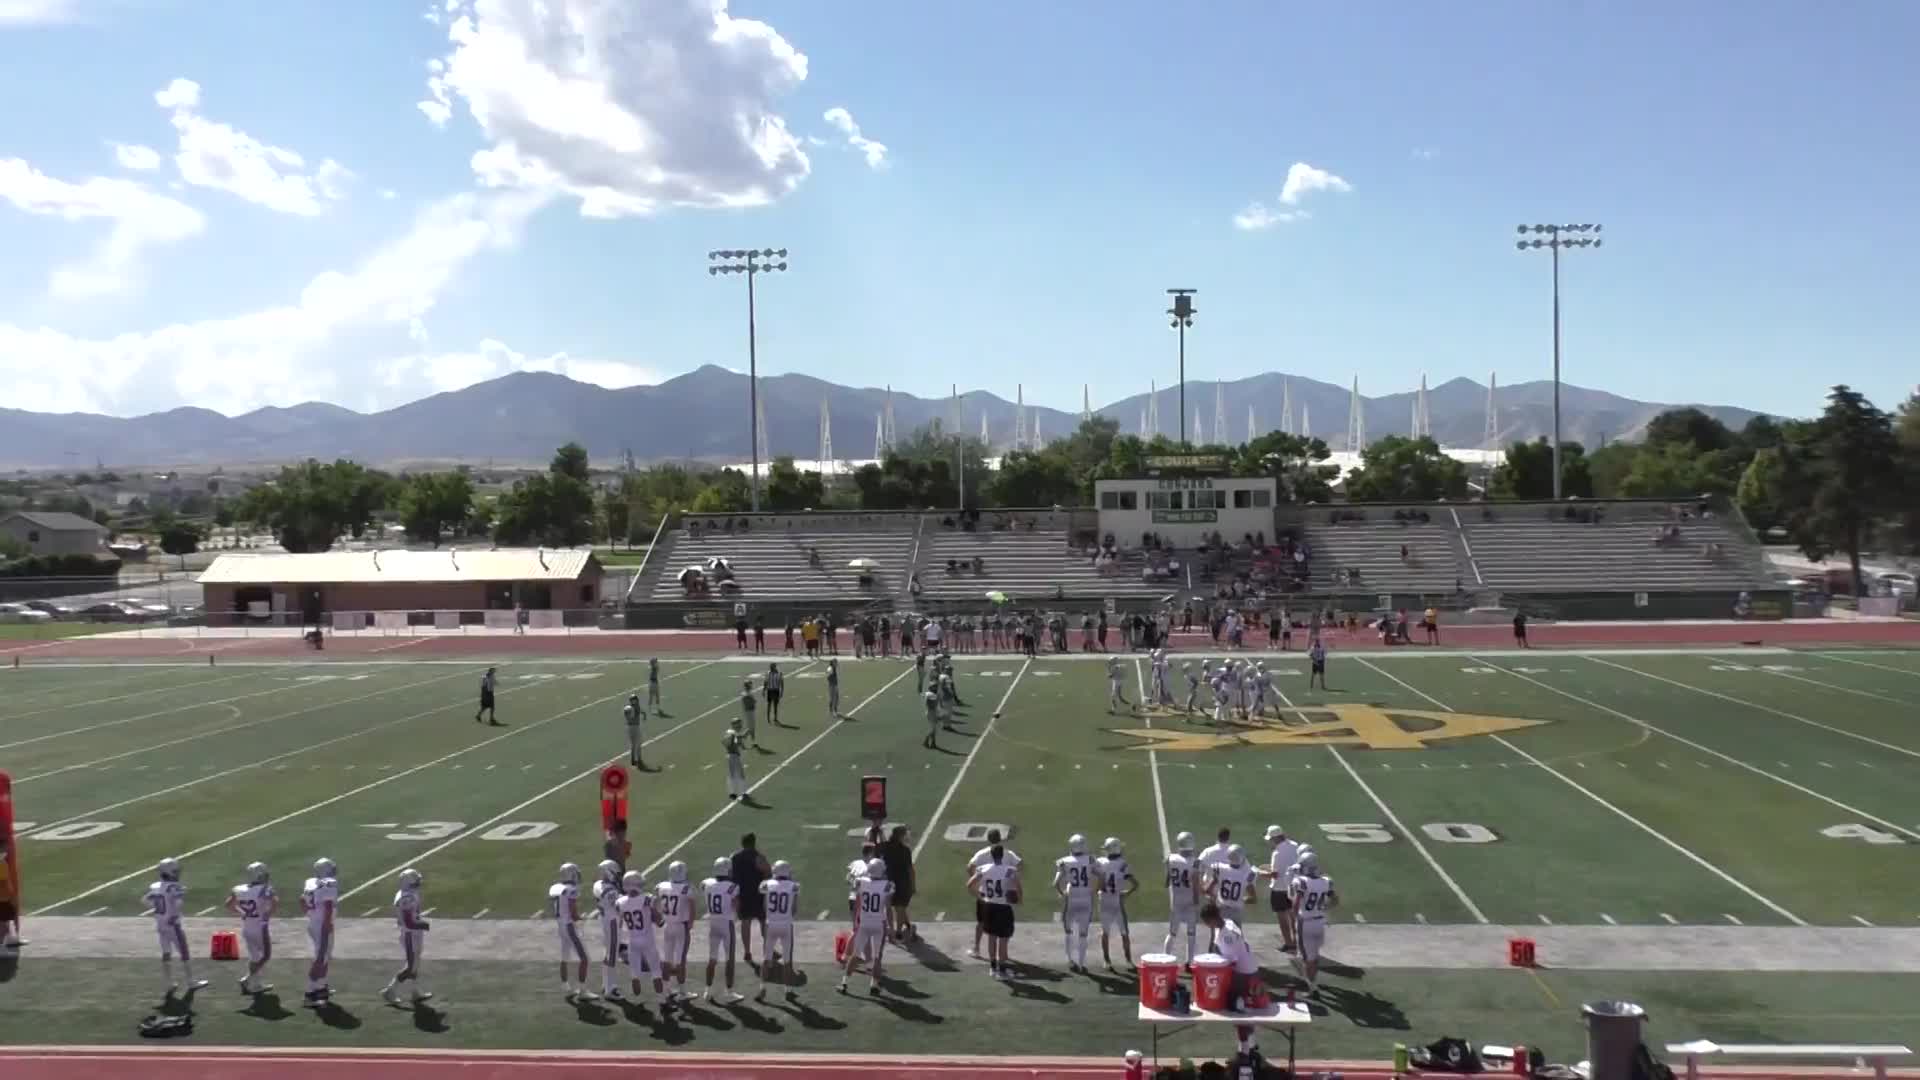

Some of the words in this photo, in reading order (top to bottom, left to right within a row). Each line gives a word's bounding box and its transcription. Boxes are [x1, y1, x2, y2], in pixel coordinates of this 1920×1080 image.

[385, 821, 560, 841] 30
[1318, 823, 1498, 843] 50
[1070, 866, 1089, 887] 34
[985, 879, 1003, 898] 64
[1220, 879, 1241, 901] 60
[768, 892, 789, 914] 90
[623, 909, 644, 931] 83
[1155, 975, 1168, 987] G
[1206, 975, 1218, 987] G
